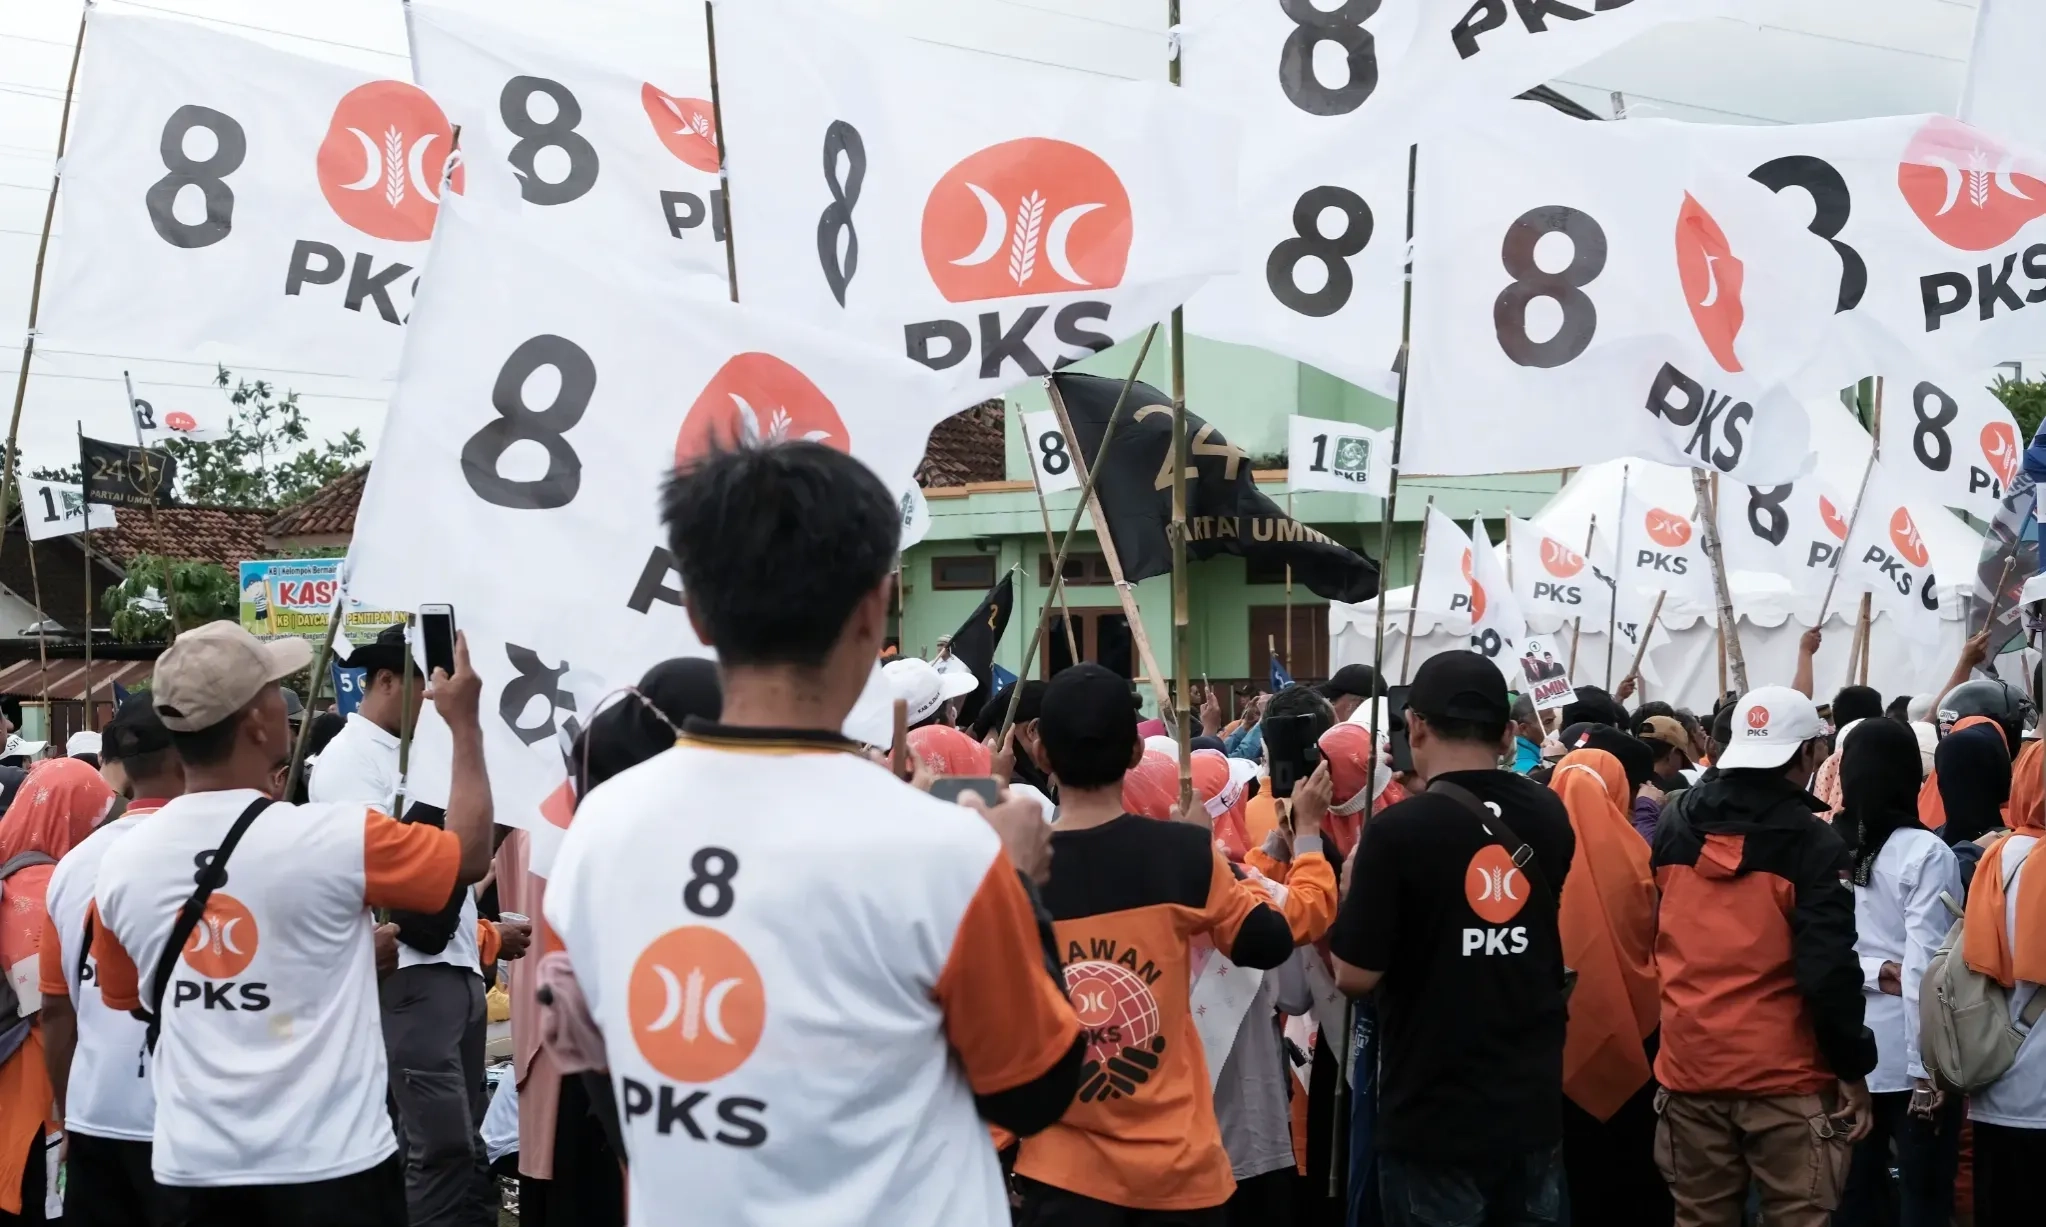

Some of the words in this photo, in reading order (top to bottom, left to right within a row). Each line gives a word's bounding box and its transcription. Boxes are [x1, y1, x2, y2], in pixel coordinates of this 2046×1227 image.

[1450, 0, 1636, 60] PK
[1279, 0, 1379, 116] 8
[500, 75, 600, 206] 8
[146, 105, 247, 249] 8
[817, 119, 867, 309] 8
[1266, 185, 1374, 318] 8
[285, 239, 420, 327] PK
[1493, 205, 1607, 369] 8
[904, 301, 1115, 380] PKS
[461, 334, 597, 510] 8
[1645, 361, 1754, 473] PKS
[1913, 381, 1958, 472] 8
[91, 456, 127, 483] 24
[1039, 430, 1070, 475] 8
[1133, 404, 1250, 491] 24
[1309, 433, 1329, 473] 1
[38, 486, 61, 523] 1
[90, 489, 125, 501] PARTAI
[127, 493, 162, 506] UMMT
[1747, 482, 1793, 547] 8
[1252, 517, 1342, 547] UMM
[1636, 550, 1689, 575] PKS
[1862, 545, 1912, 595] PKS
[277, 613, 290, 627] KB
[345, 611, 393, 625] PENITIPAN
[1533, 582, 1582, 605] PKS
[340, 673, 354, 693] 5
[1534, 677, 1570, 702] AMIN
[1746, 728, 1769, 738] PKS
[683, 846, 740, 918] 8
[1061, 937, 1163, 986] AWAN
[1462, 926, 1529, 957] PKS
[173, 980, 271, 1012] PKS
[622, 1076, 768, 1150] PKS
